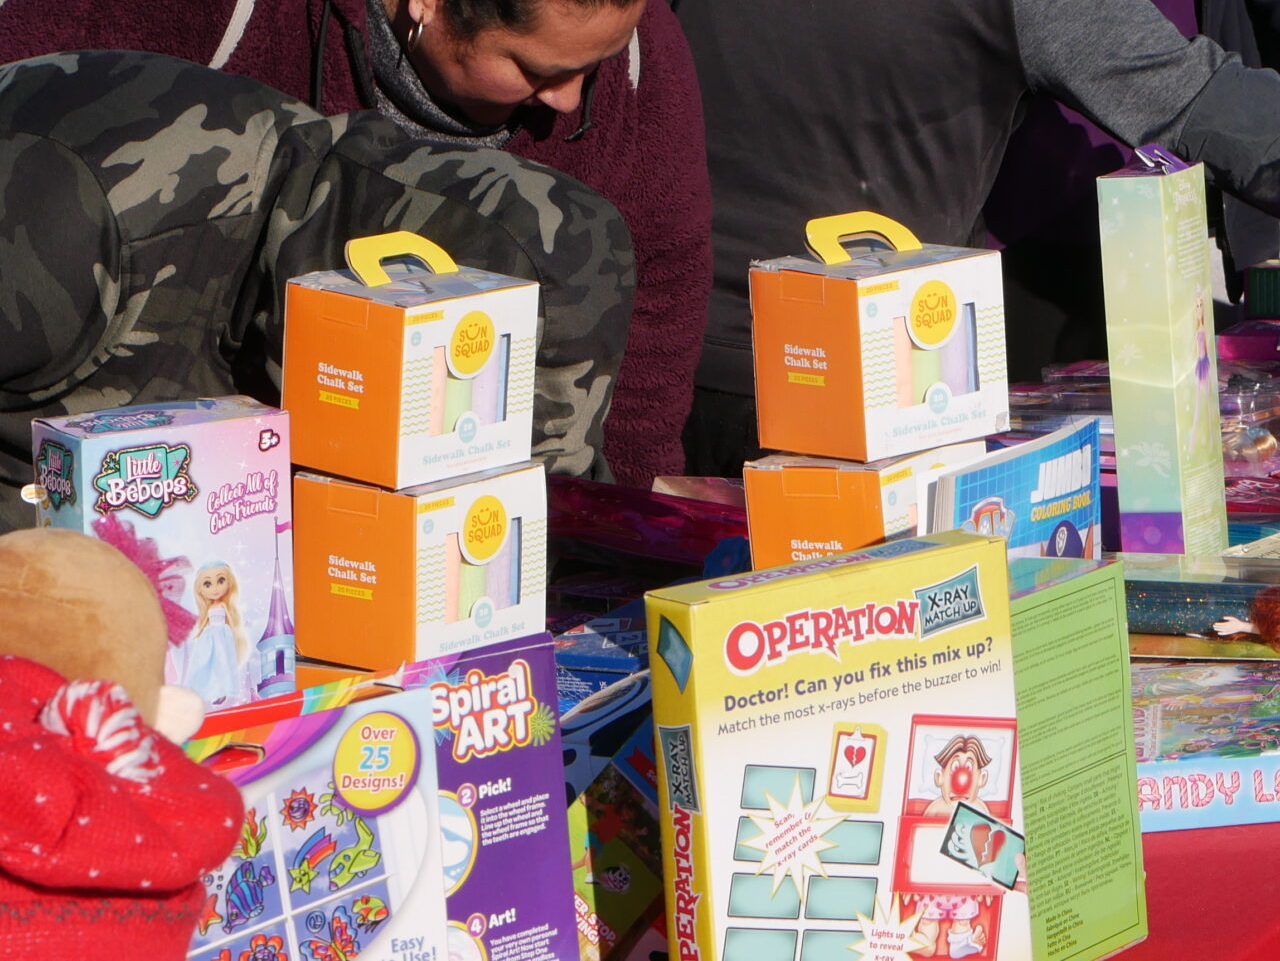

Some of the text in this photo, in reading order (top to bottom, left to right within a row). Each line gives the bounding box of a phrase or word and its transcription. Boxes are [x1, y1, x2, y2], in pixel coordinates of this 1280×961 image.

[918, 292, 949, 311] SUN
[915, 309, 952, 329] SQUAD
[459, 324, 488, 342] SUN
[455, 340, 490, 358] SQUAD
[784, 343, 826, 358] Sidewalk
[317, 362, 364, 382] Sidewalk
[784, 356, 828, 370] Chalk Set
[317, 374, 364, 394] Chalk Set
[892, 419, 939, 439] Sidewalk
[940, 412, 969, 428] Chalk
[971, 409, 987, 421] Set
[422, 448, 465, 466] Sidewalk
[467, 441, 495, 456] Chalk
[496, 439, 511, 450] Set
[126, 452, 162, 482] Little
[106, 476, 187, 506] Bebops
[207, 470, 277, 514] Collect All of
[210, 497, 276, 535] Our Friends
[472, 508, 499, 527] SUN
[1031, 491, 1092, 523] COLORING BOOK
[468, 524, 502, 544] SQUAD
[790, 539, 843, 551] Sidewalk
[328, 554, 376, 573] Sidewalk
[328, 566, 377, 585] Chalk Set
[928, 585, 970, 611] X-RAY
[925, 599, 977, 627] MATCH UP
[439, 622, 525, 653] Sidewalk Chalk Set
[726, 600, 919, 671] OPERATION
[724, 636, 993, 712] Doctor! Can you fix this mix up?
[431, 662, 527, 726] Spiral
[718, 659, 1001, 736] Match the most x-rays before the buzzer to win!
[361, 726, 395, 740] Over
[456, 701, 532, 756] ART
[360, 746, 390, 769] 25
[669, 741, 681, 795] X-RAY
[342, 774, 404, 792] Designs!
[461, 777, 512, 804] 2 Pick!
[1137, 770, 1241, 812] ANDY
[774, 812, 795, 829] Scan,
[765, 821, 801, 849] remember
[774, 825, 812, 855] match the
[777, 834, 818, 867] x-ray cards
[672, 805, 700, 961] PERATION
[471, 908, 516, 932] 4 Art!
[391, 936, 424, 953] Easy
[869, 941, 903, 951] to reveal
[871, 929, 905, 941] Lights up
